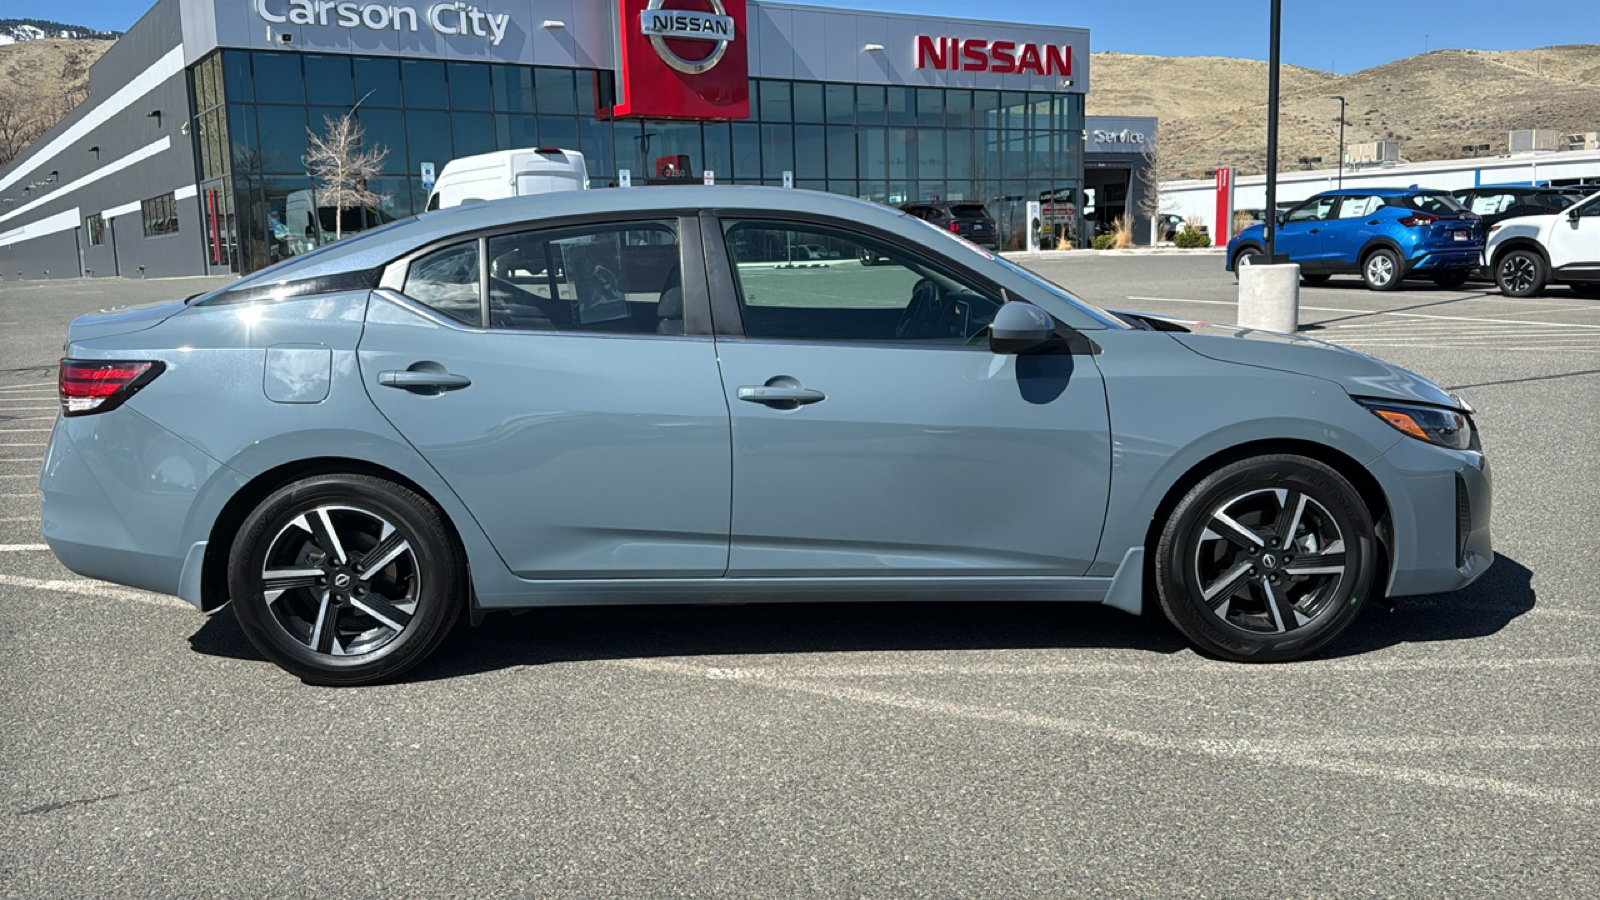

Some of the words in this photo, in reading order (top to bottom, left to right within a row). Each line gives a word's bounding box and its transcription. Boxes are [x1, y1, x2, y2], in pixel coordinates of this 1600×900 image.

[256, 0, 418, 31] Carson
[429, 3, 510, 45] City
[652, 15, 728, 35] NISSAN
[914, 34, 1073, 77] NISSAN
[1094, 128, 1145, 144] Service
